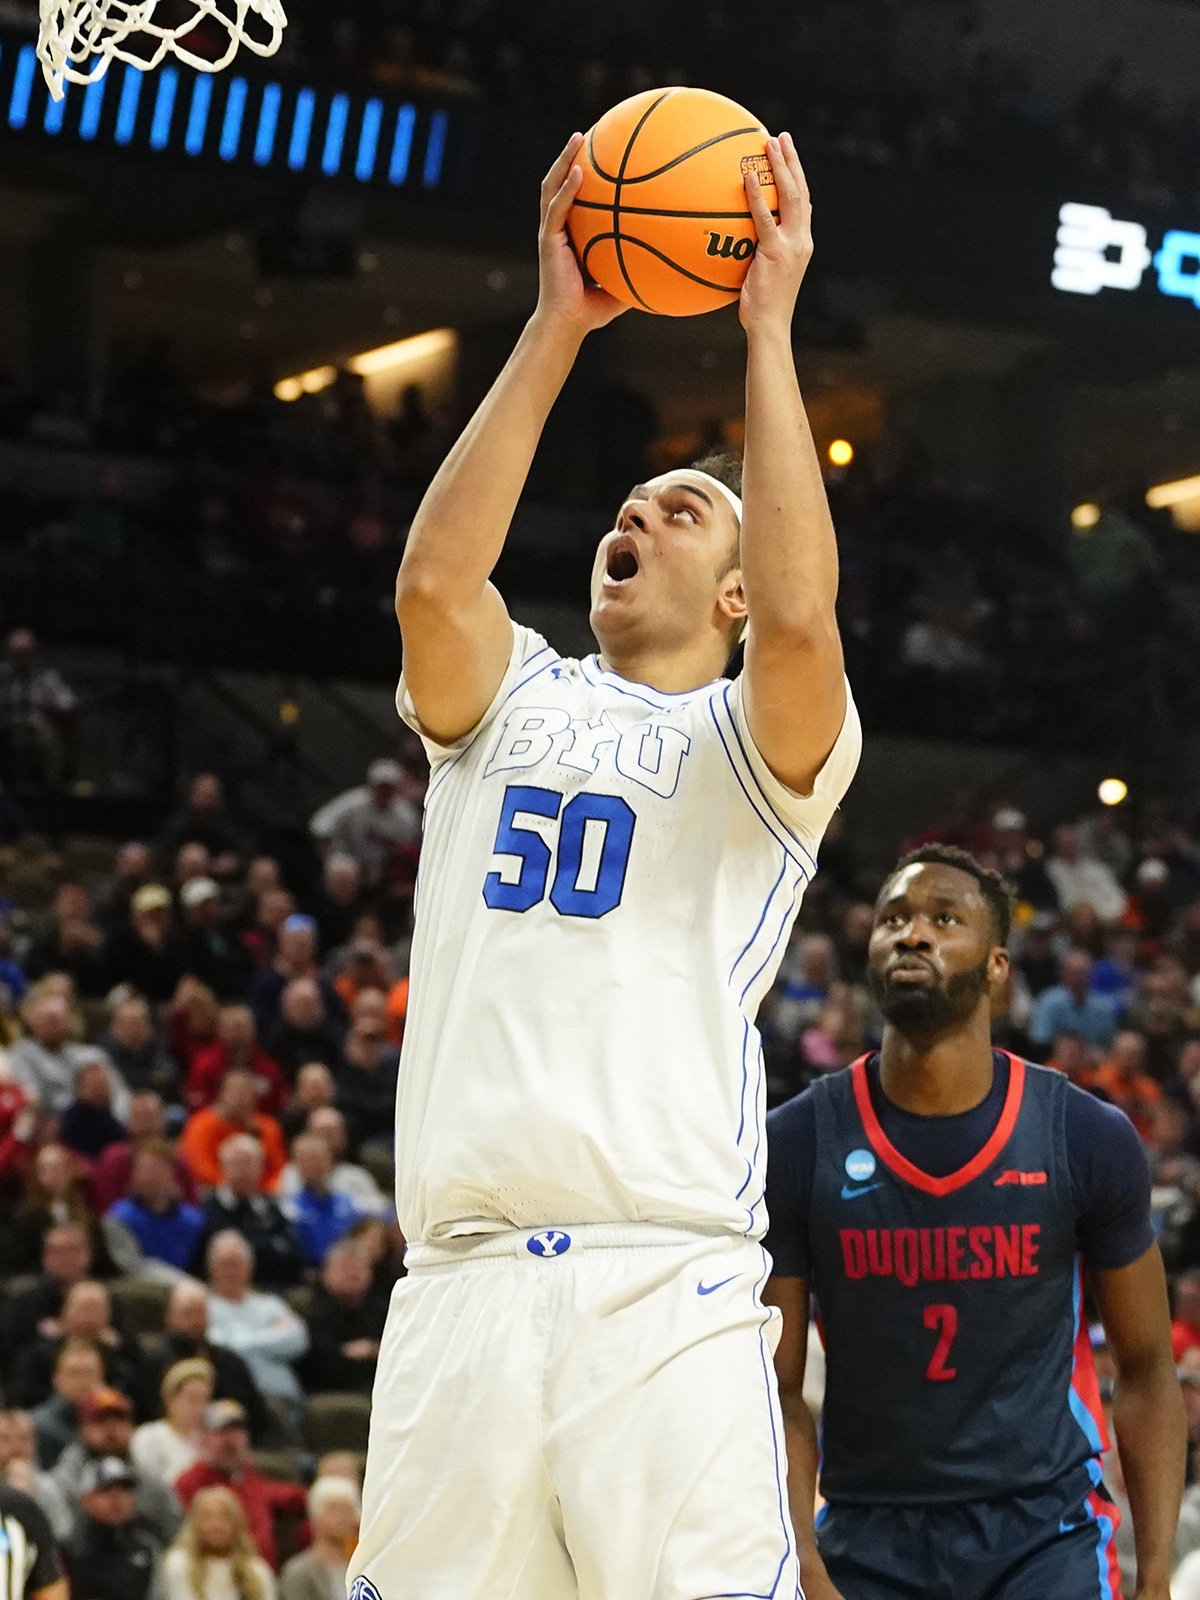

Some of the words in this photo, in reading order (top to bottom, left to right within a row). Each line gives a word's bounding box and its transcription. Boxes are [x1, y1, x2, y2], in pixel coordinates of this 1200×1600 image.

[482, 706, 692, 799] BYU
[482, 785, 638, 919] 50
[533, 1231, 566, 1257] Y
[838, 1223, 1042, 1288] DUQUESNE
[923, 1303, 958, 1381] 2
